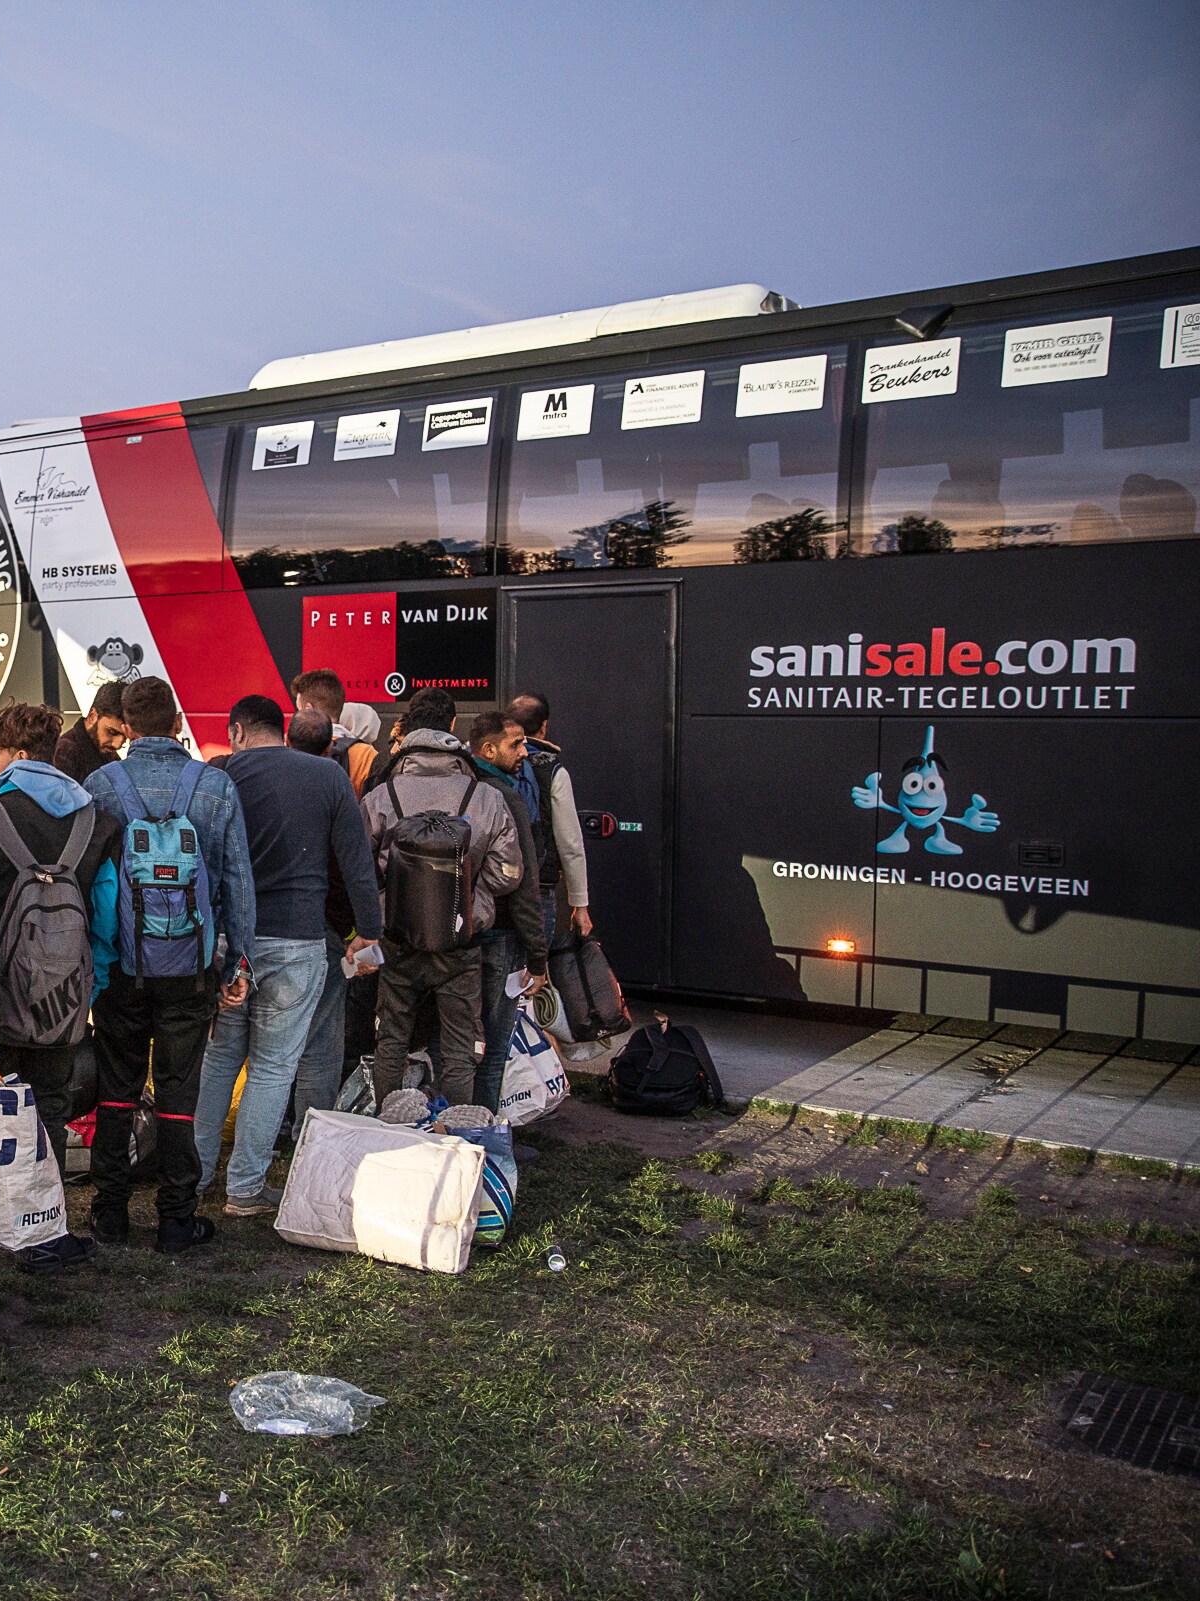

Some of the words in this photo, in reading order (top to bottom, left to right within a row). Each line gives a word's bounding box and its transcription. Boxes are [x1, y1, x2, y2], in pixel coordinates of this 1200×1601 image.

[1056, 331, 1104, 347] GRILL
[869, 348, 951, 374] Drankenhandel
[1013, 352, 1031, 364] Ook
[784, 378, 817, 389] REIZEN
[868, 365, 953, 393] Beukers
[430, 419, 460, 430] Centrum
[459, 416, 485, 427] Emmen
[542, 412, 568, 420] mitra
[42, 567, 59, 579] HB
[61, 563, 117, 578] SYSTEMS
[310, 610, 392, 628] PETER
[748, 627, 1137, 678] sanisale.com
[389, 678, 401, 691] &
[747, 685, 1136, 711] SANITAIR-TEGELOUTLET
[772, 860, 906, 886] GRONINGEN
[929, 869, 1091, 897] HOOGEVEEN
[500, 1089, 532, 1109] ACTION
[21, 1204, 61, 1227] ACTION
